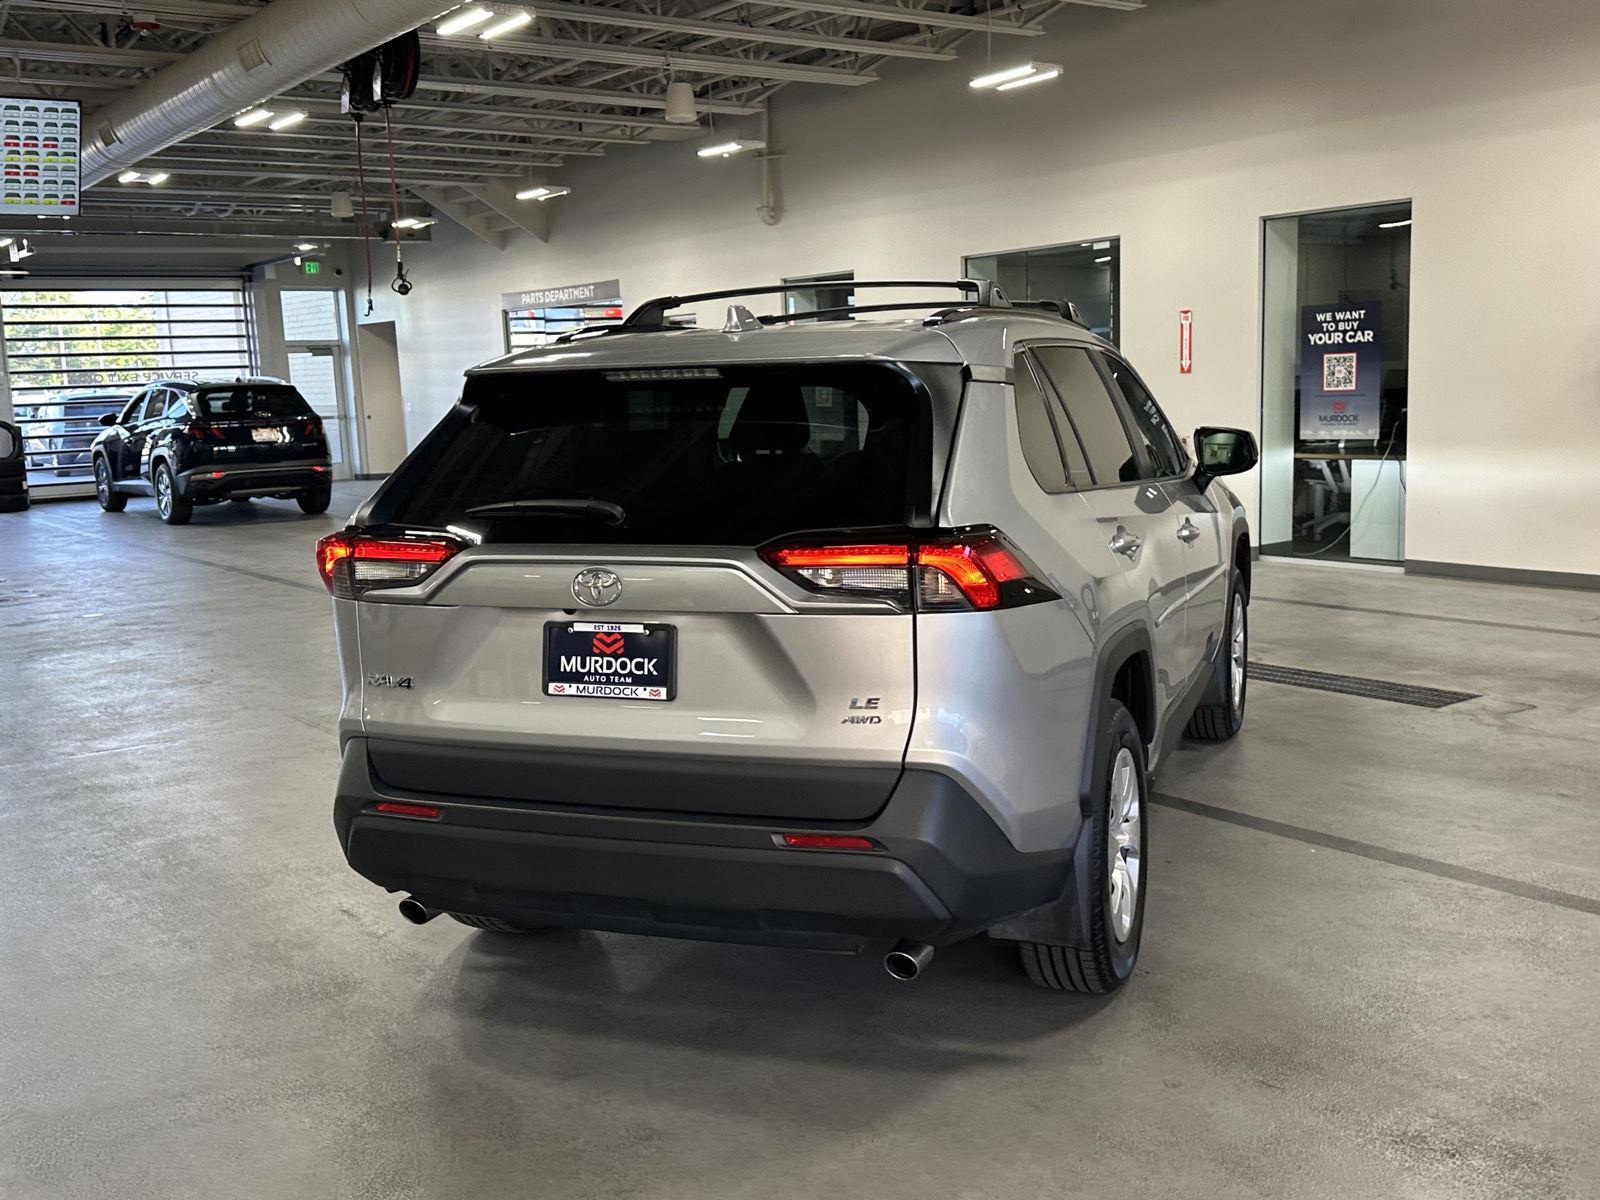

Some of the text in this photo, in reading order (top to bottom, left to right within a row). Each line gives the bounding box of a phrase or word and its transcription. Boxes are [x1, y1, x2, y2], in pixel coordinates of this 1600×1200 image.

[305, 262, 320, 274] EXIT
[521, 285, 595, 305] PARTS DEPARTMENT
[1316, 310, 1366, 322] WE WANT
[1322, 321, 1359, 332] TO BUY
[1308, 330, 1374, 345] YOUR CAR
[1318, 414, 1360, 423] MURDOCK
[560, 655, 658, 676] MURDOCK
[583, 675, 607, 683] AUTO
[575, 684, 639, 697] MURDOCK
[848, 697, 880, 710] LE
[840, 715, 882, 725] AWD
